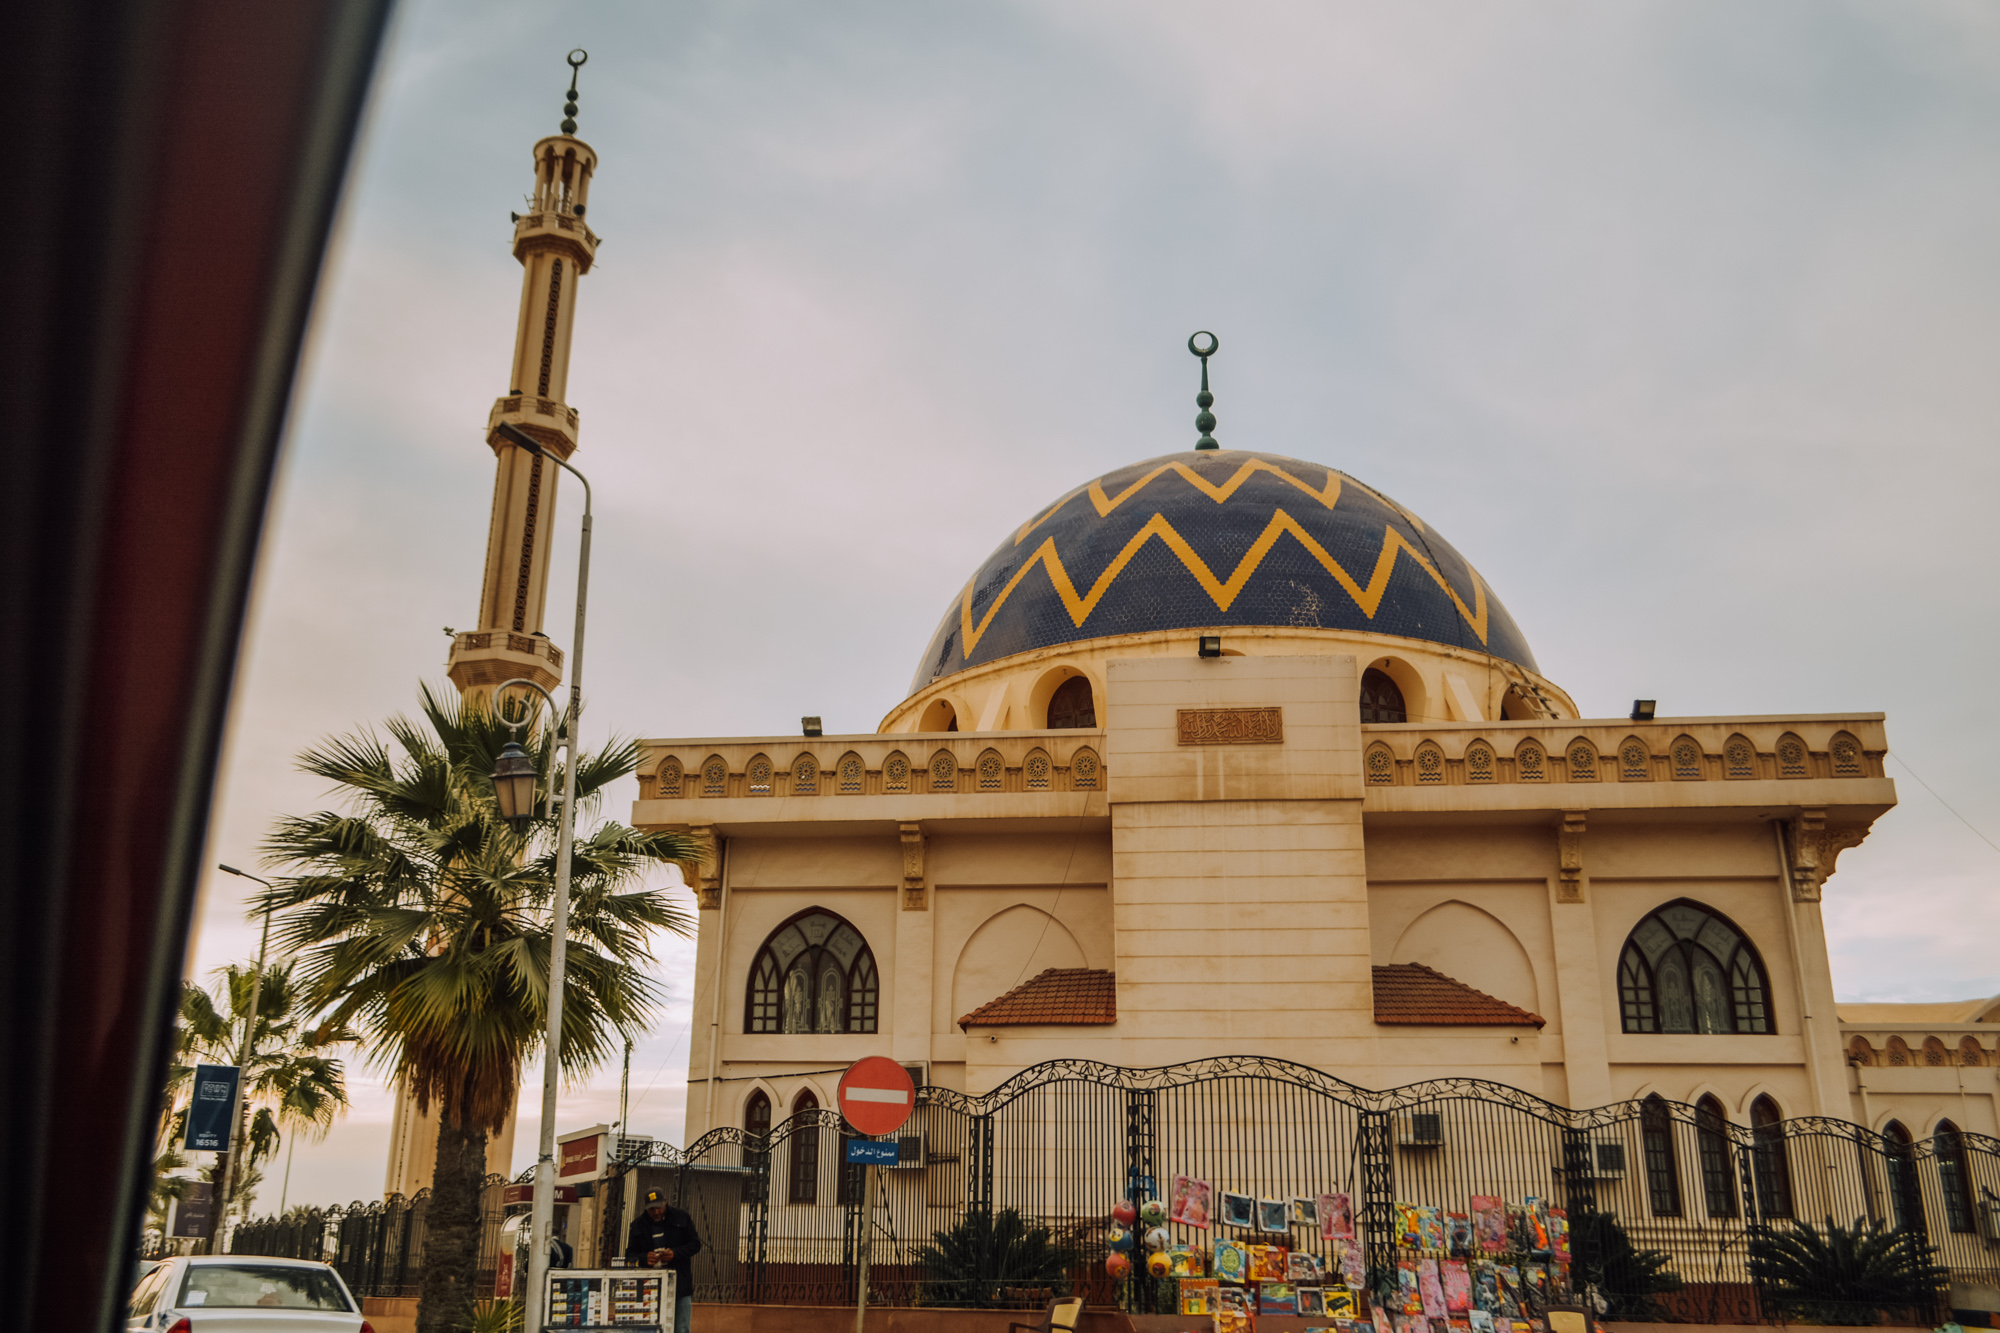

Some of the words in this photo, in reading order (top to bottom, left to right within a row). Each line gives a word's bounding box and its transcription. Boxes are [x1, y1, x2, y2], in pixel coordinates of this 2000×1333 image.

[195, 1138, 219, 1147] 16516
[850, 1146, 876, 1156] الدخول
[876, 1148, 895, 1158] ممنوع
